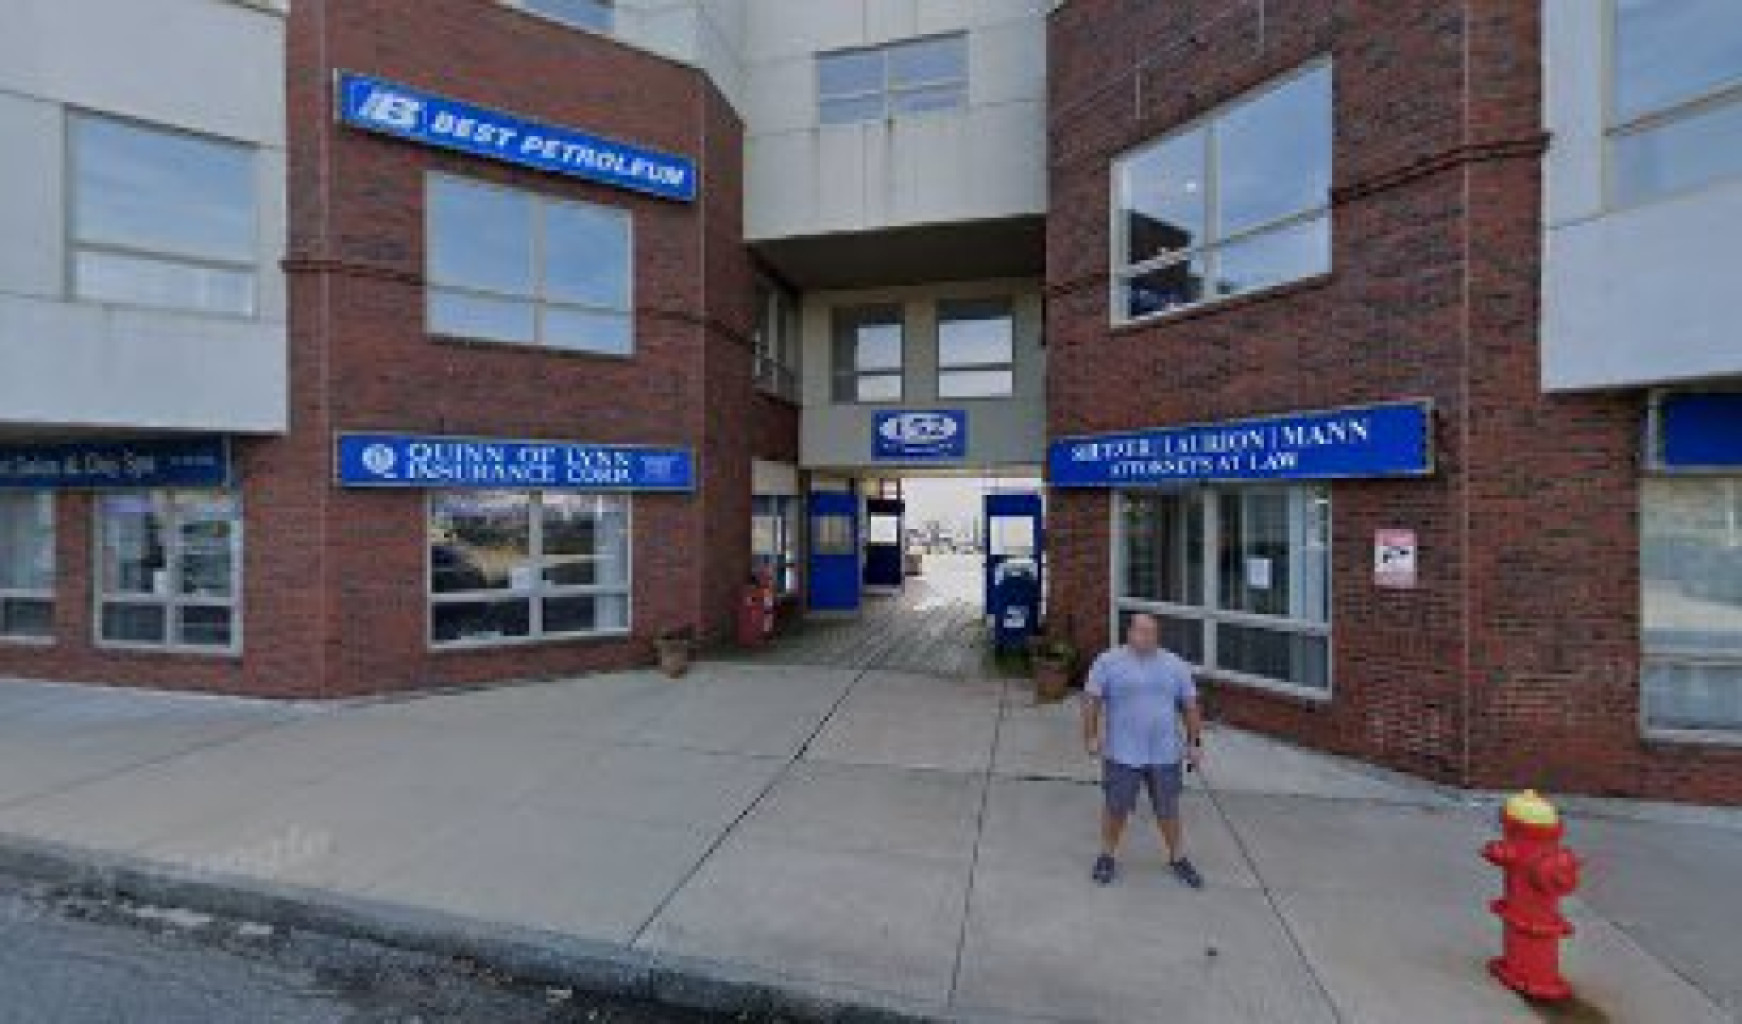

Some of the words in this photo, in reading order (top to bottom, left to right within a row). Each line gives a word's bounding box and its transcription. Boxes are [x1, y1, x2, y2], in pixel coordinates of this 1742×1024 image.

[432, 111, 517, 151] BEST
[520, 135, 686, 186] PETROLEUM
[1283, 417, 1370, 449] MANN
[408, 443, 504, 463] QUINN
[519, 447, 555, 464] OF
[566, 449, 630, 467] LYNN
[1249, 451, 1300, 473] LAW
[408, 462, 556, 480] INSURANCE
